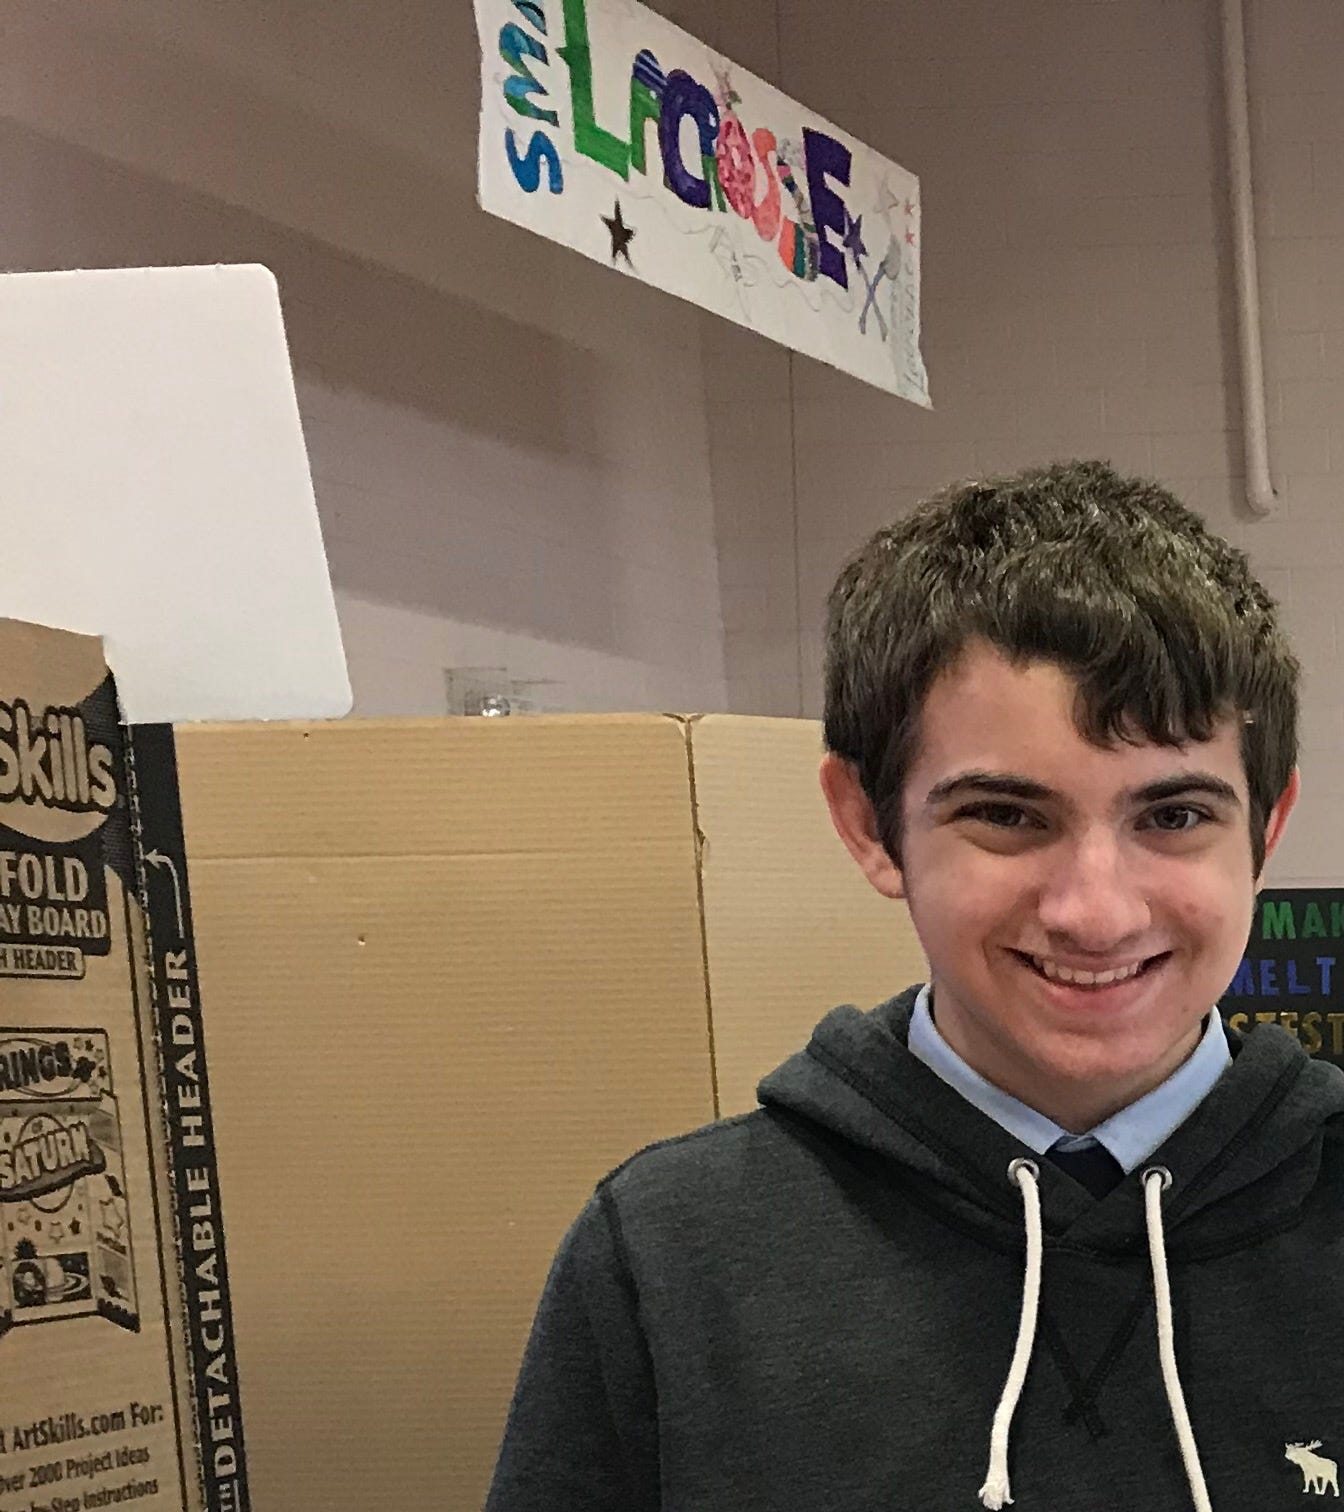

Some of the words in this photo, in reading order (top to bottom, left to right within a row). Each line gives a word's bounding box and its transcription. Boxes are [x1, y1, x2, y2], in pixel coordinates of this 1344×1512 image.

[27, 904, 107, 938] BOARD
[14, 949, 77, 972] HEADER
[165, 948, 205, 1146] HEADER
[0, 1124, 90, 1188] SATURN
[186, 1168, 237, 1478] DETACHABLE
[13, 1412, 126, 1451] ArtSkills.com
[130, 1402, 164, 1428] For:
[29, 1461, 63, 1488] 2000
[66, 1452, 114, 1480] Project
[116, 1446, 150, 1468] Ideas
[83, 1478, 159, 1510] Instructions
